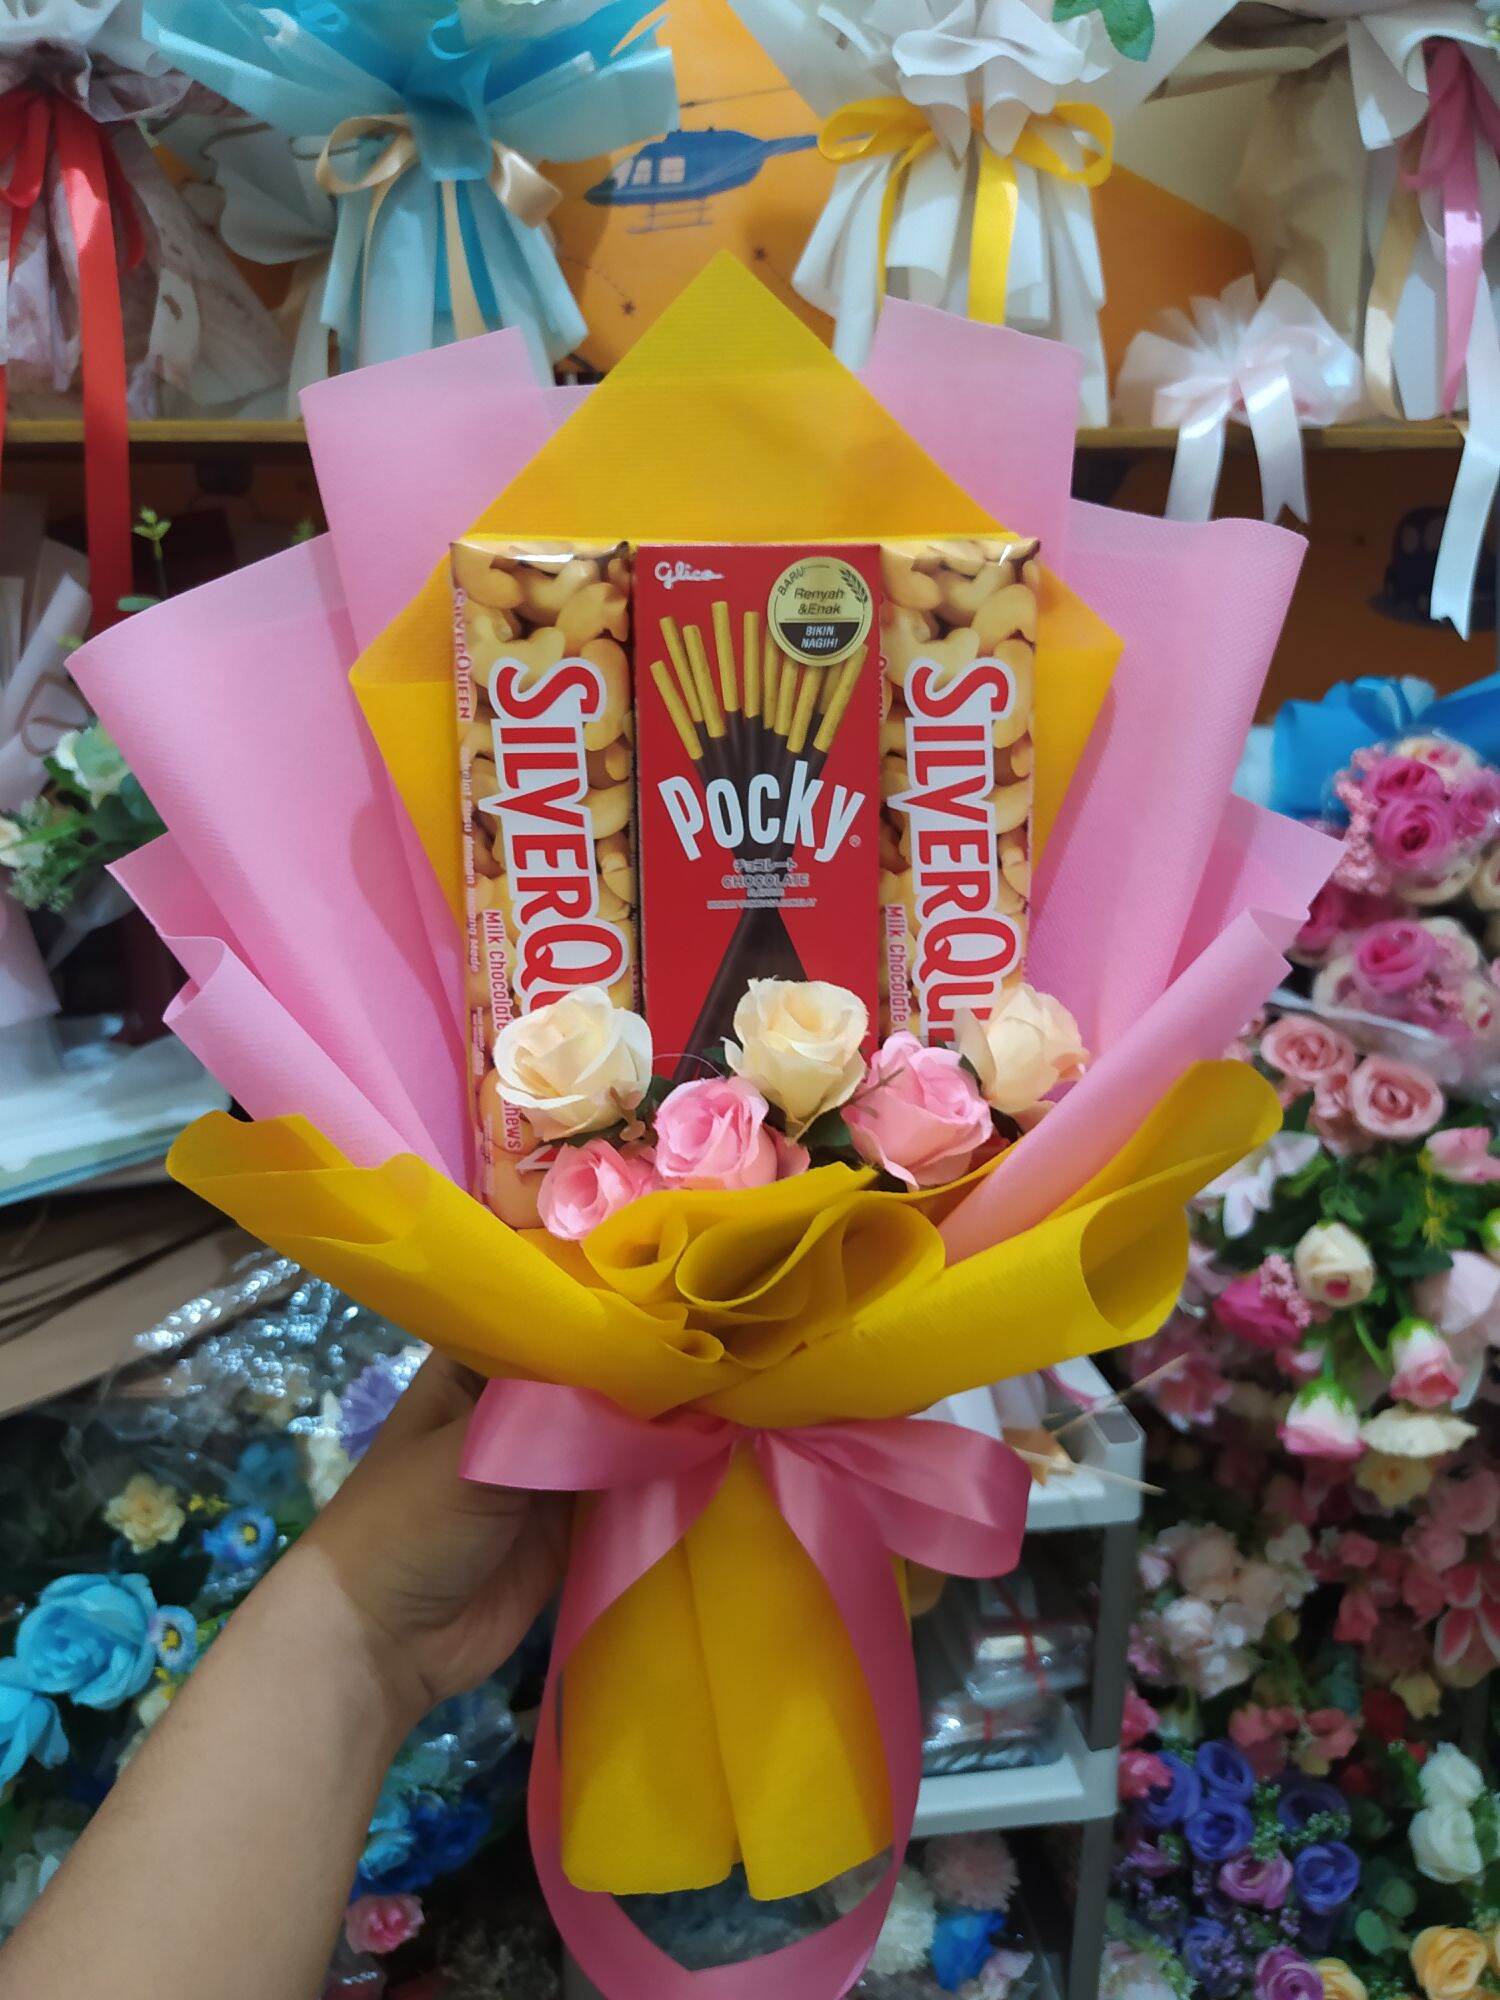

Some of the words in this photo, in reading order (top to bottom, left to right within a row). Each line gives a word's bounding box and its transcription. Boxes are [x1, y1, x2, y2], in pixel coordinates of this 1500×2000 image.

[654, 560, 725, 590] Glico
[794, 587, 845, 602] Renyah
[801, 638, 839, 648] NAGIH!
[805, 625, 835, 636] BIKIN
[903, 665, 1016, 1051] SILVERQU
[721, 873, 810, 889] CHOCOLATE
[484, 911, 502, 944] Milk
[494, 665, 623, 1163] SILVERQ
[887, 905, 906, 938] Milk
[488, 950, 513, 1030] Chocolate
[889, 944, 910, 1022] Chocolate
